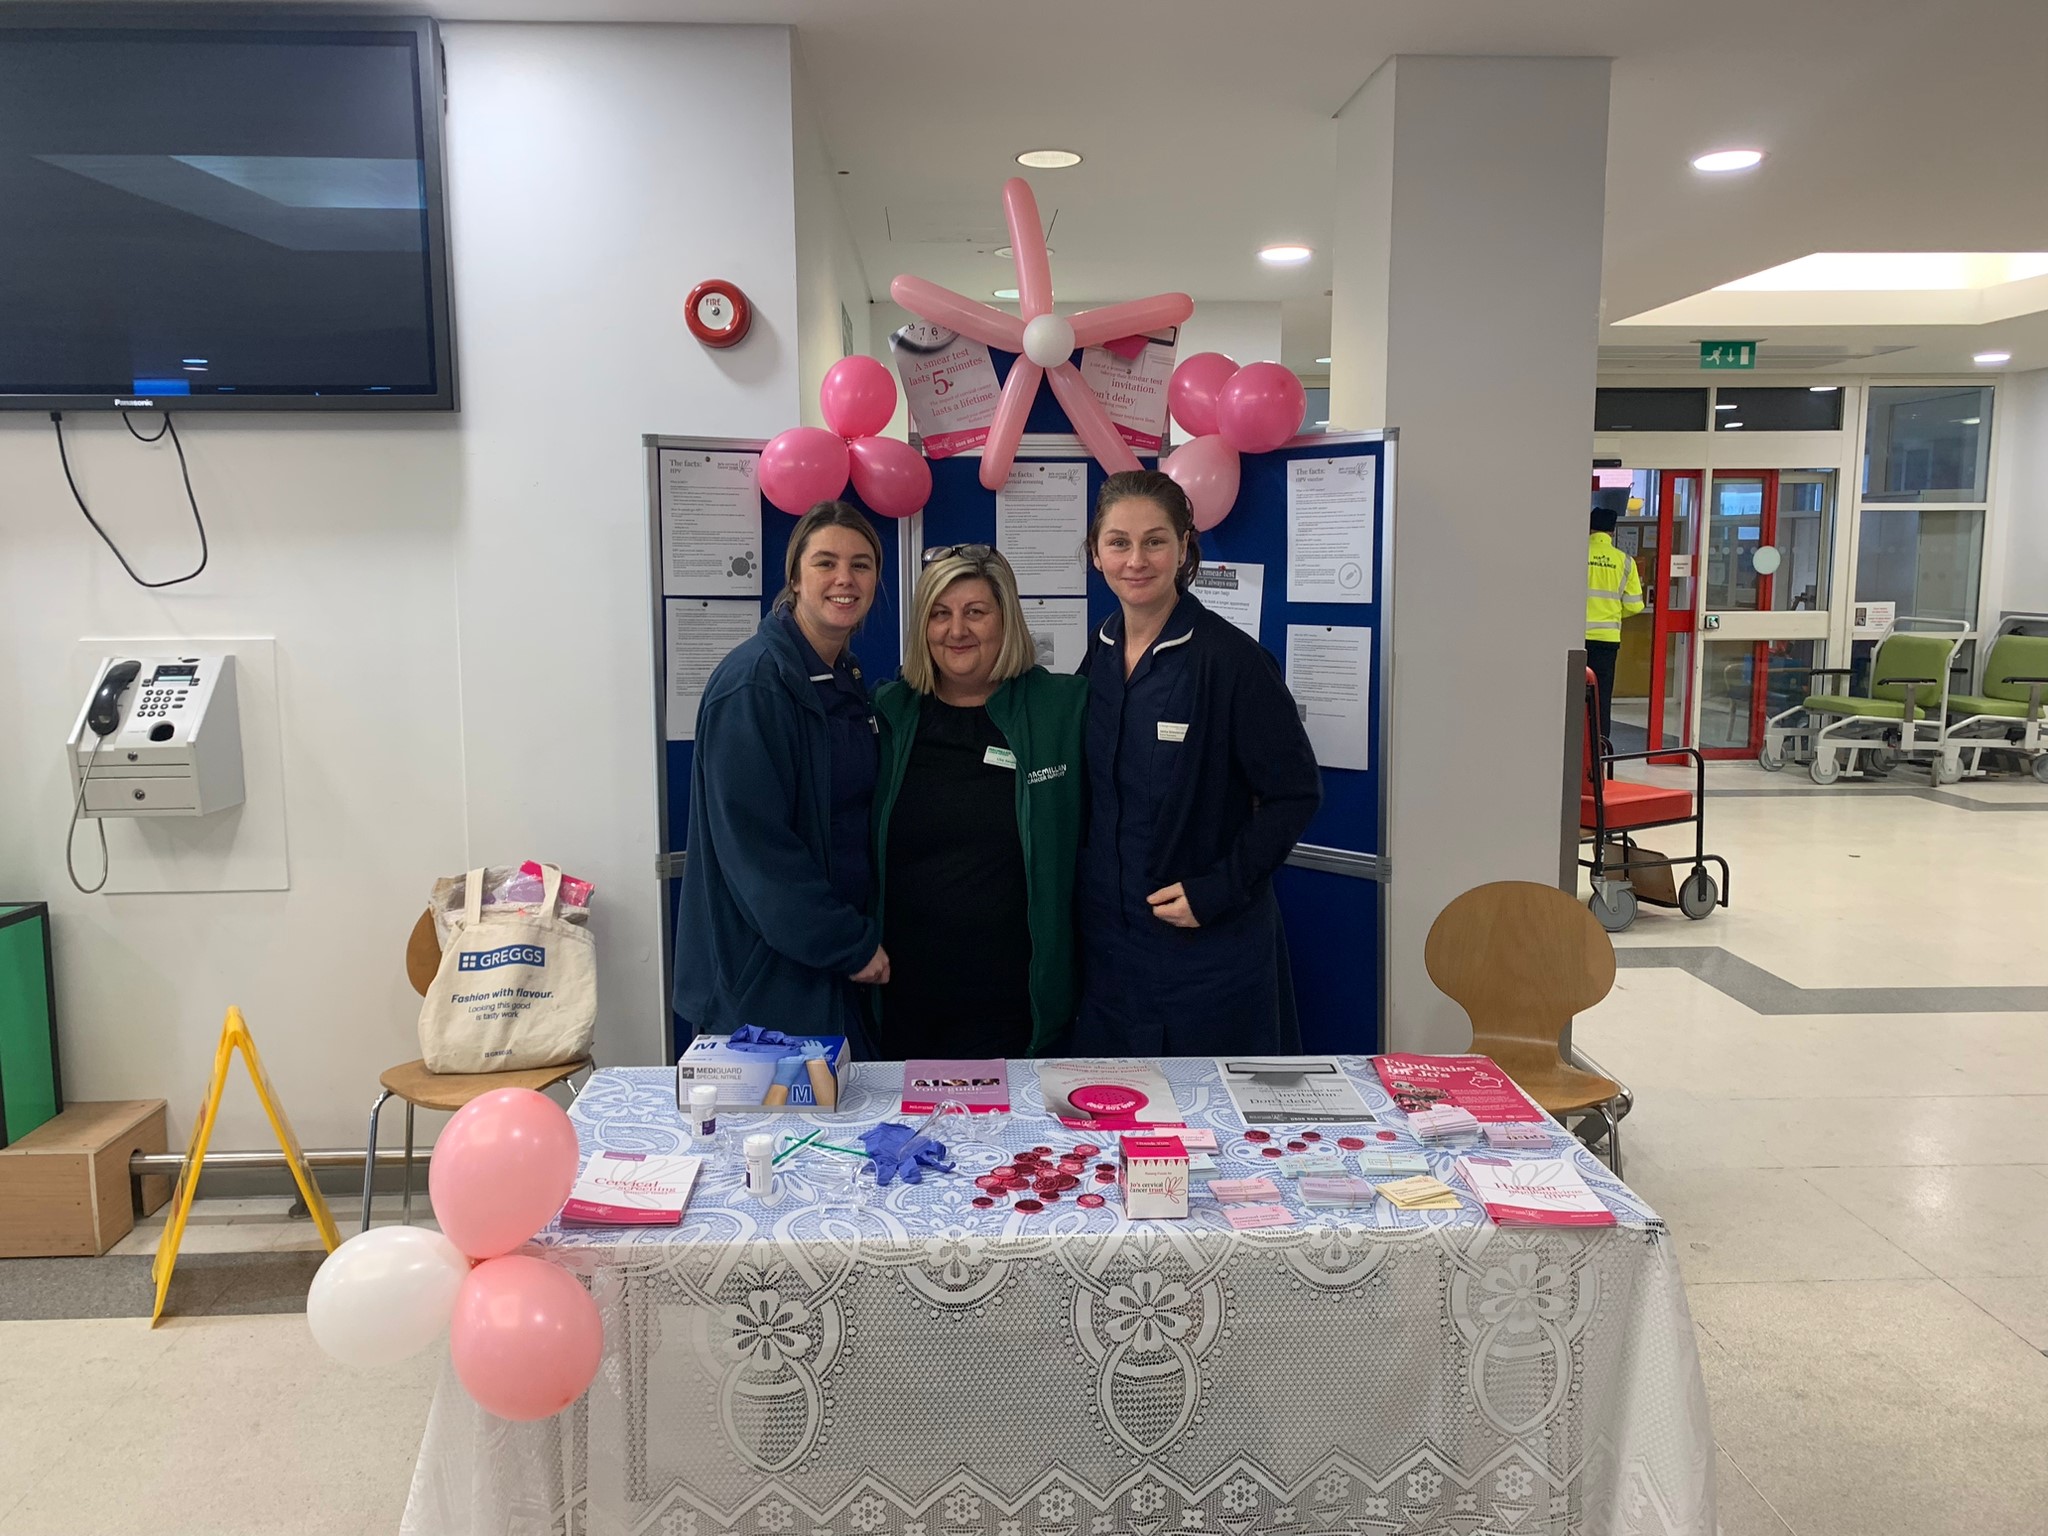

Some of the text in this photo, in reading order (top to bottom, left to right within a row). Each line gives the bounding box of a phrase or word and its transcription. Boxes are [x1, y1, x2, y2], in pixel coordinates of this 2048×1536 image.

[706, 298, 721, 306] FIRE
[920, 327, 925, 336] 7
[931, 327, 938, 336] 6
[914, 348, 969, 372] A smear test
[908, 358, 986, 396] lasts 5 minutes.
[1128, 374, 1149, 383] smear
[1150, 378, 1163, 386] test
[1111, 378, 1157, 395] invitation.
[114, 398, 154, 406] Panasonic
[931, 406, 952, 417] lasts
[959, 393, 996, 408] lifetime.
[1112, 393, 1136, 406] delay
[669, 459, 702, 468] The facts:
[1224, 570, 1235, 578] test
[479, 947, 542, 967] GREGGS
[451, 987, 554, 1004] Fashion with flavour.
[468, 1001, 531, 1013] Looking this good
[476, 1011, 519, 1021] is tasty work
[693, 1042, 717, 1050] M
[696, 1067, 743, 1075] MEDIGUARD
[1382, 1057, 1477, 1073] Fundraise
[1386, 1065, 1450, 1078] for Jo's
[792, 1084, 812, 1103] M
[948, 1086, 982, 1094] guide
[595, 1177, 660, 1187] Cervical
[1494, 1182, 1557, 1191] Human
